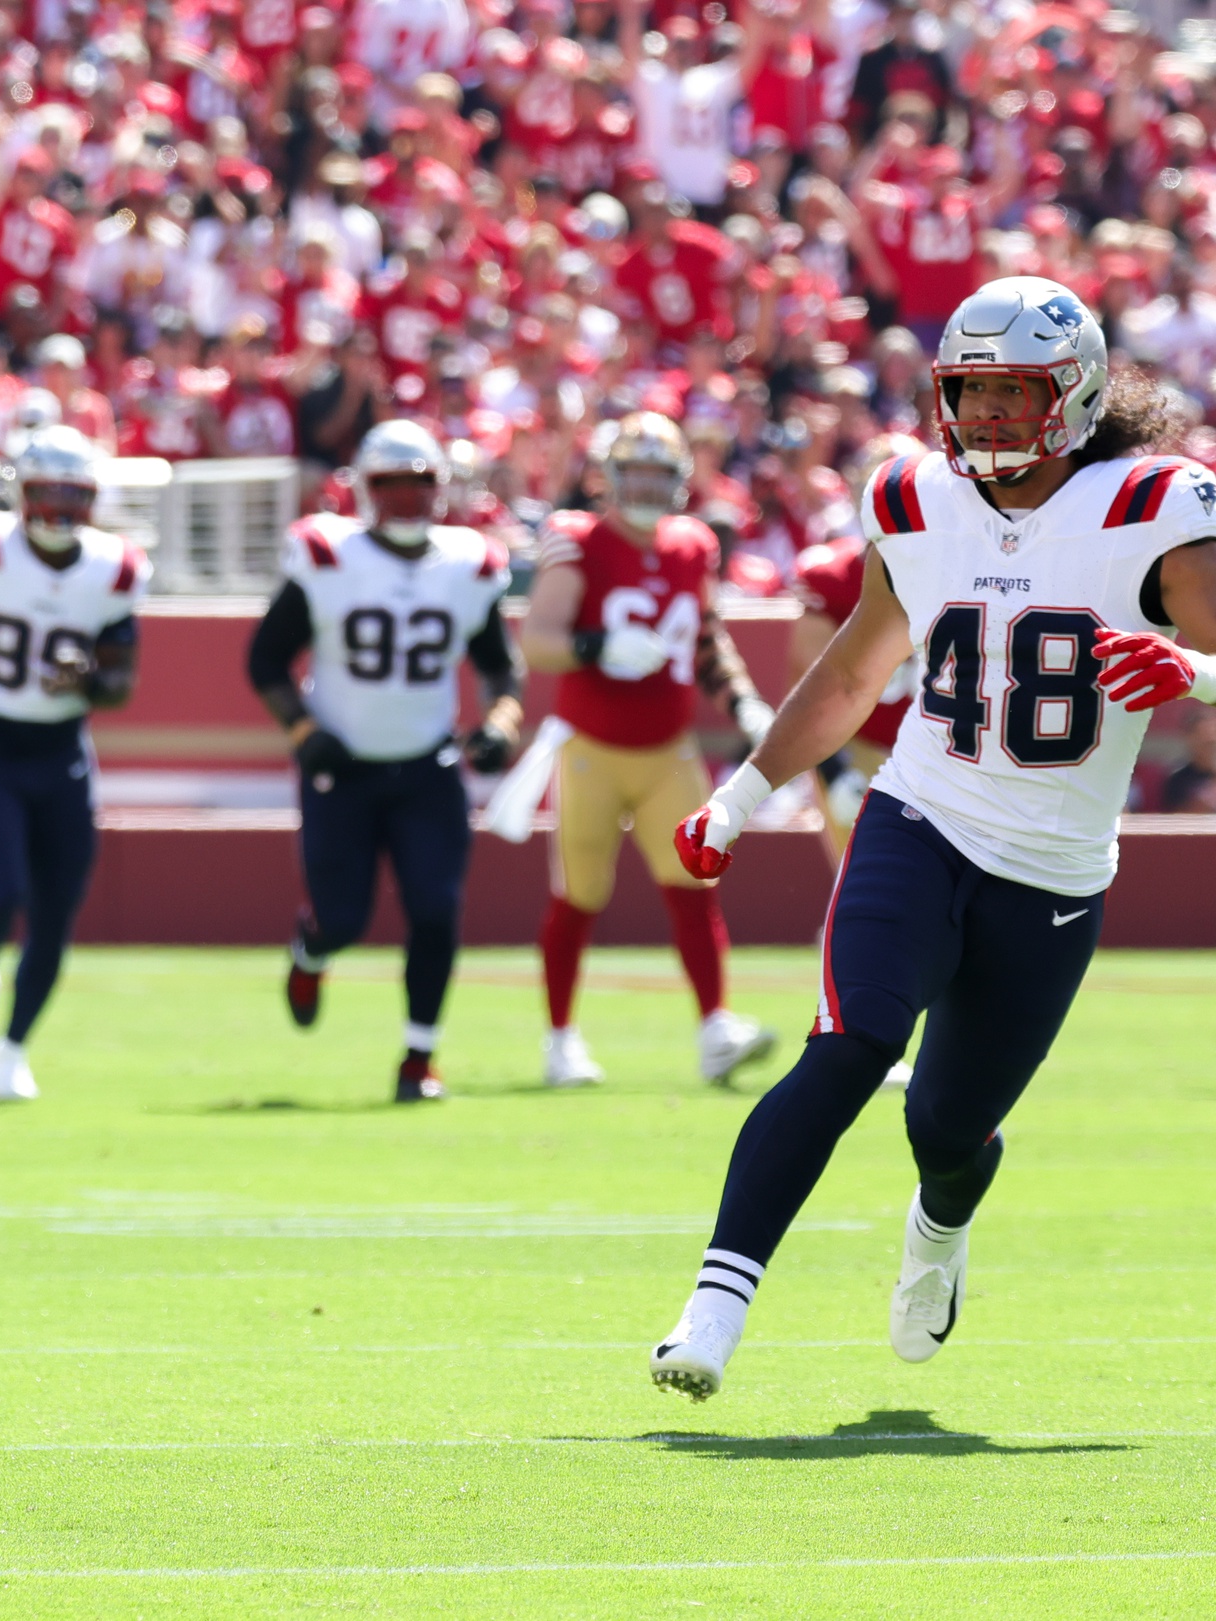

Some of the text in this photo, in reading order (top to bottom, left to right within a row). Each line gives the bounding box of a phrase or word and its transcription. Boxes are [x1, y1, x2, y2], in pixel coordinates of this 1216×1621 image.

[973, 576, 1031, 593] PATRIOTS
[344, 607, 454, 683] 92
[920, 602, 1109, 769] 48
